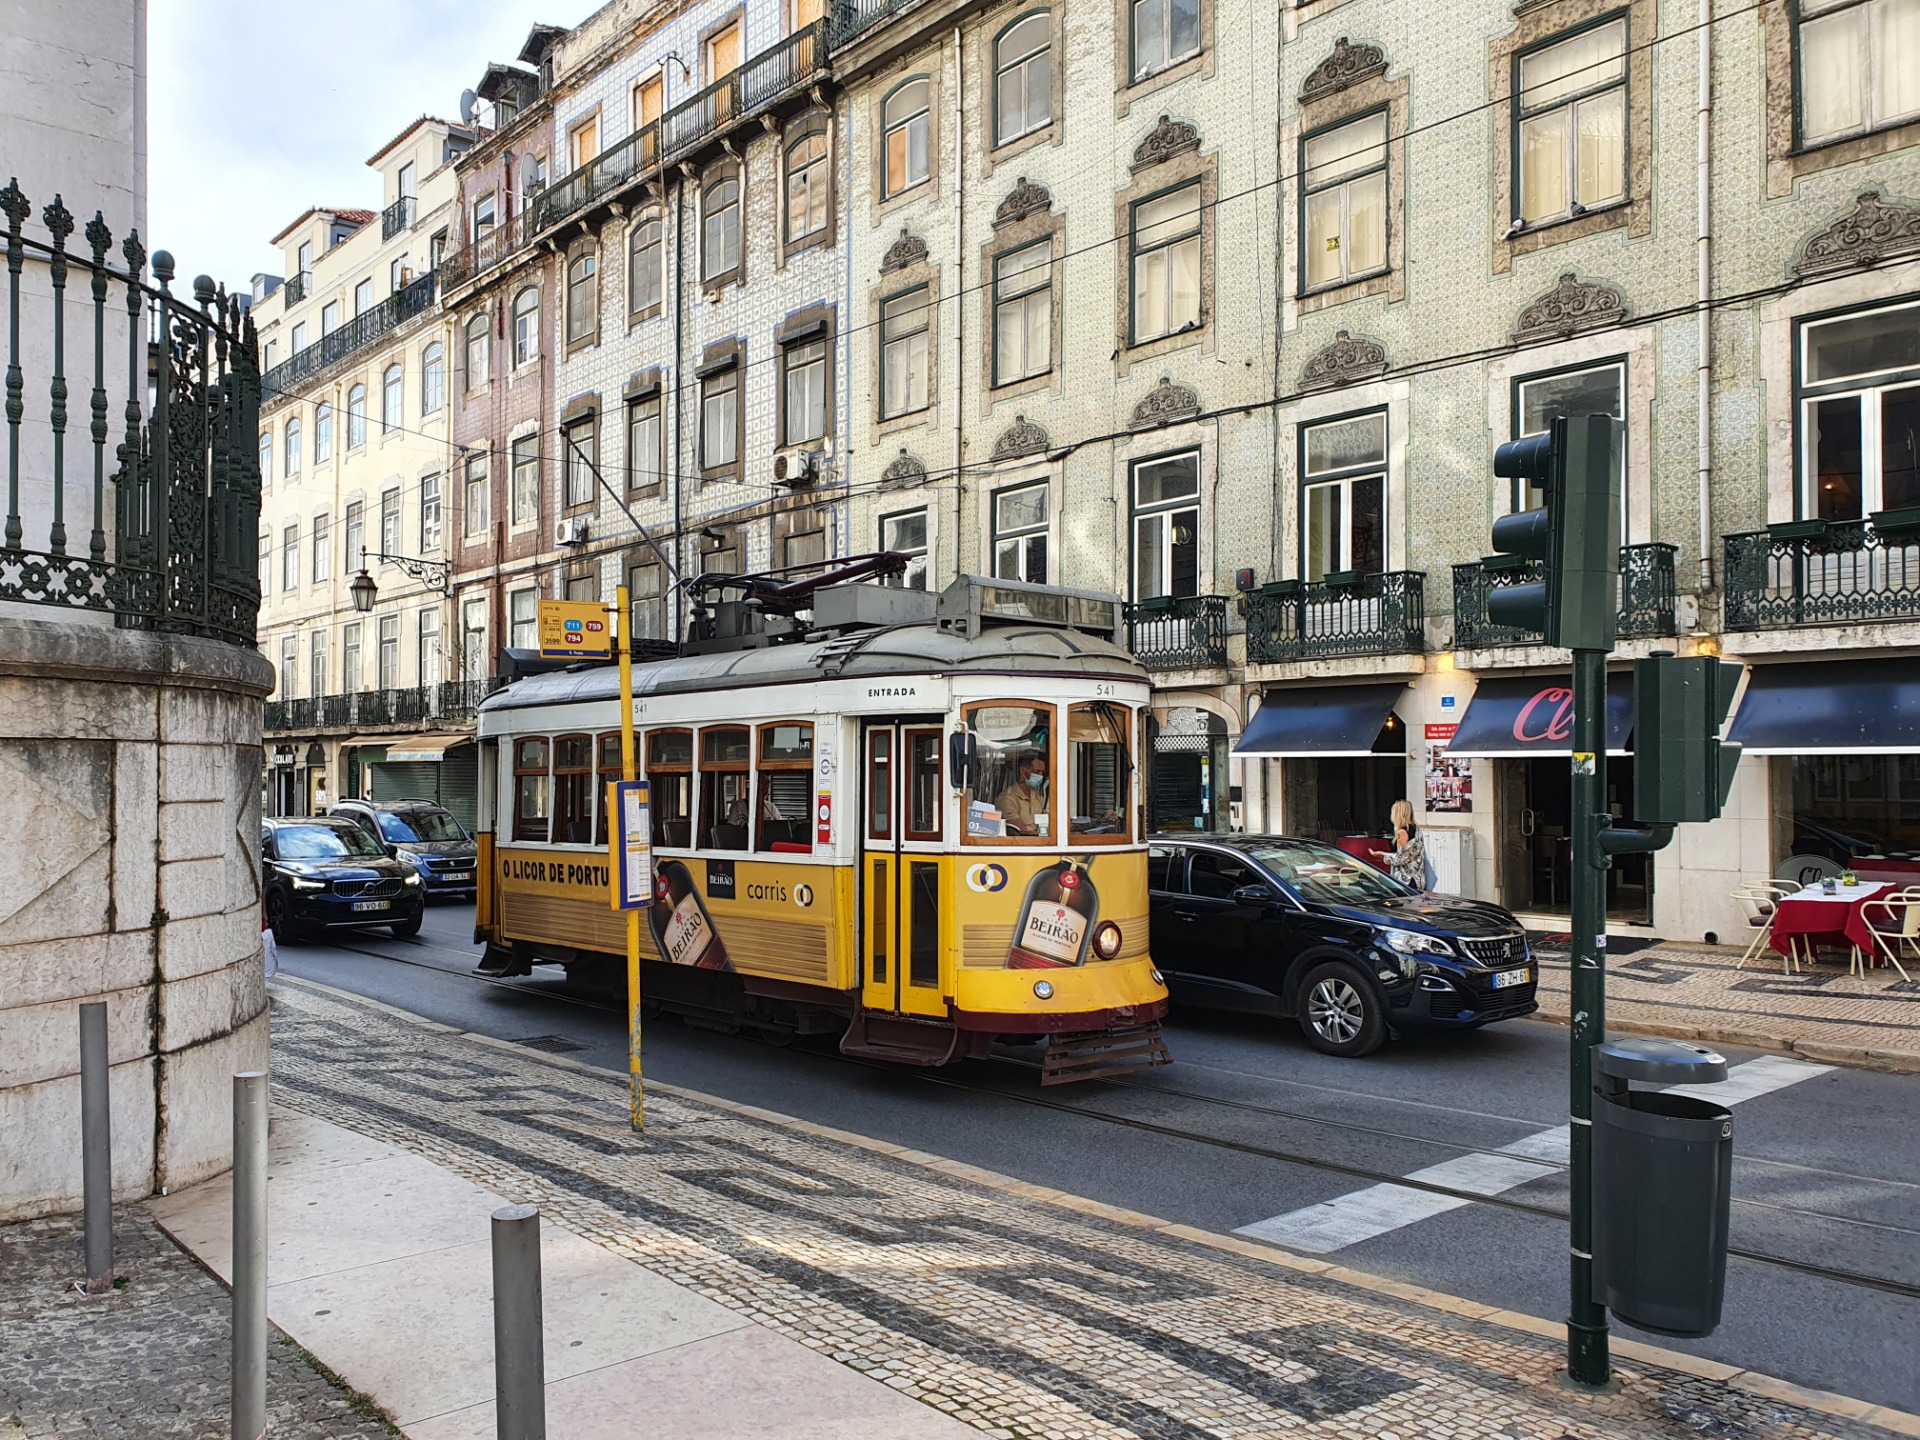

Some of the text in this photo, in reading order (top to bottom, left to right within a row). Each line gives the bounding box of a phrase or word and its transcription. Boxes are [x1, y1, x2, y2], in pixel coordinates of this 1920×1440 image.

[868, 687, 916, 698] ENTRADA
[1096, 684, 1115, 696] 541
[634, 704, 647, 714] 541
[970, 810, 983, 819] 12E
[503, 859, 610, 888] O LICOR DE PORTU
[747, 880, 787, 902] carris
[1029, 916, 1079, 945] BEIRÃO
